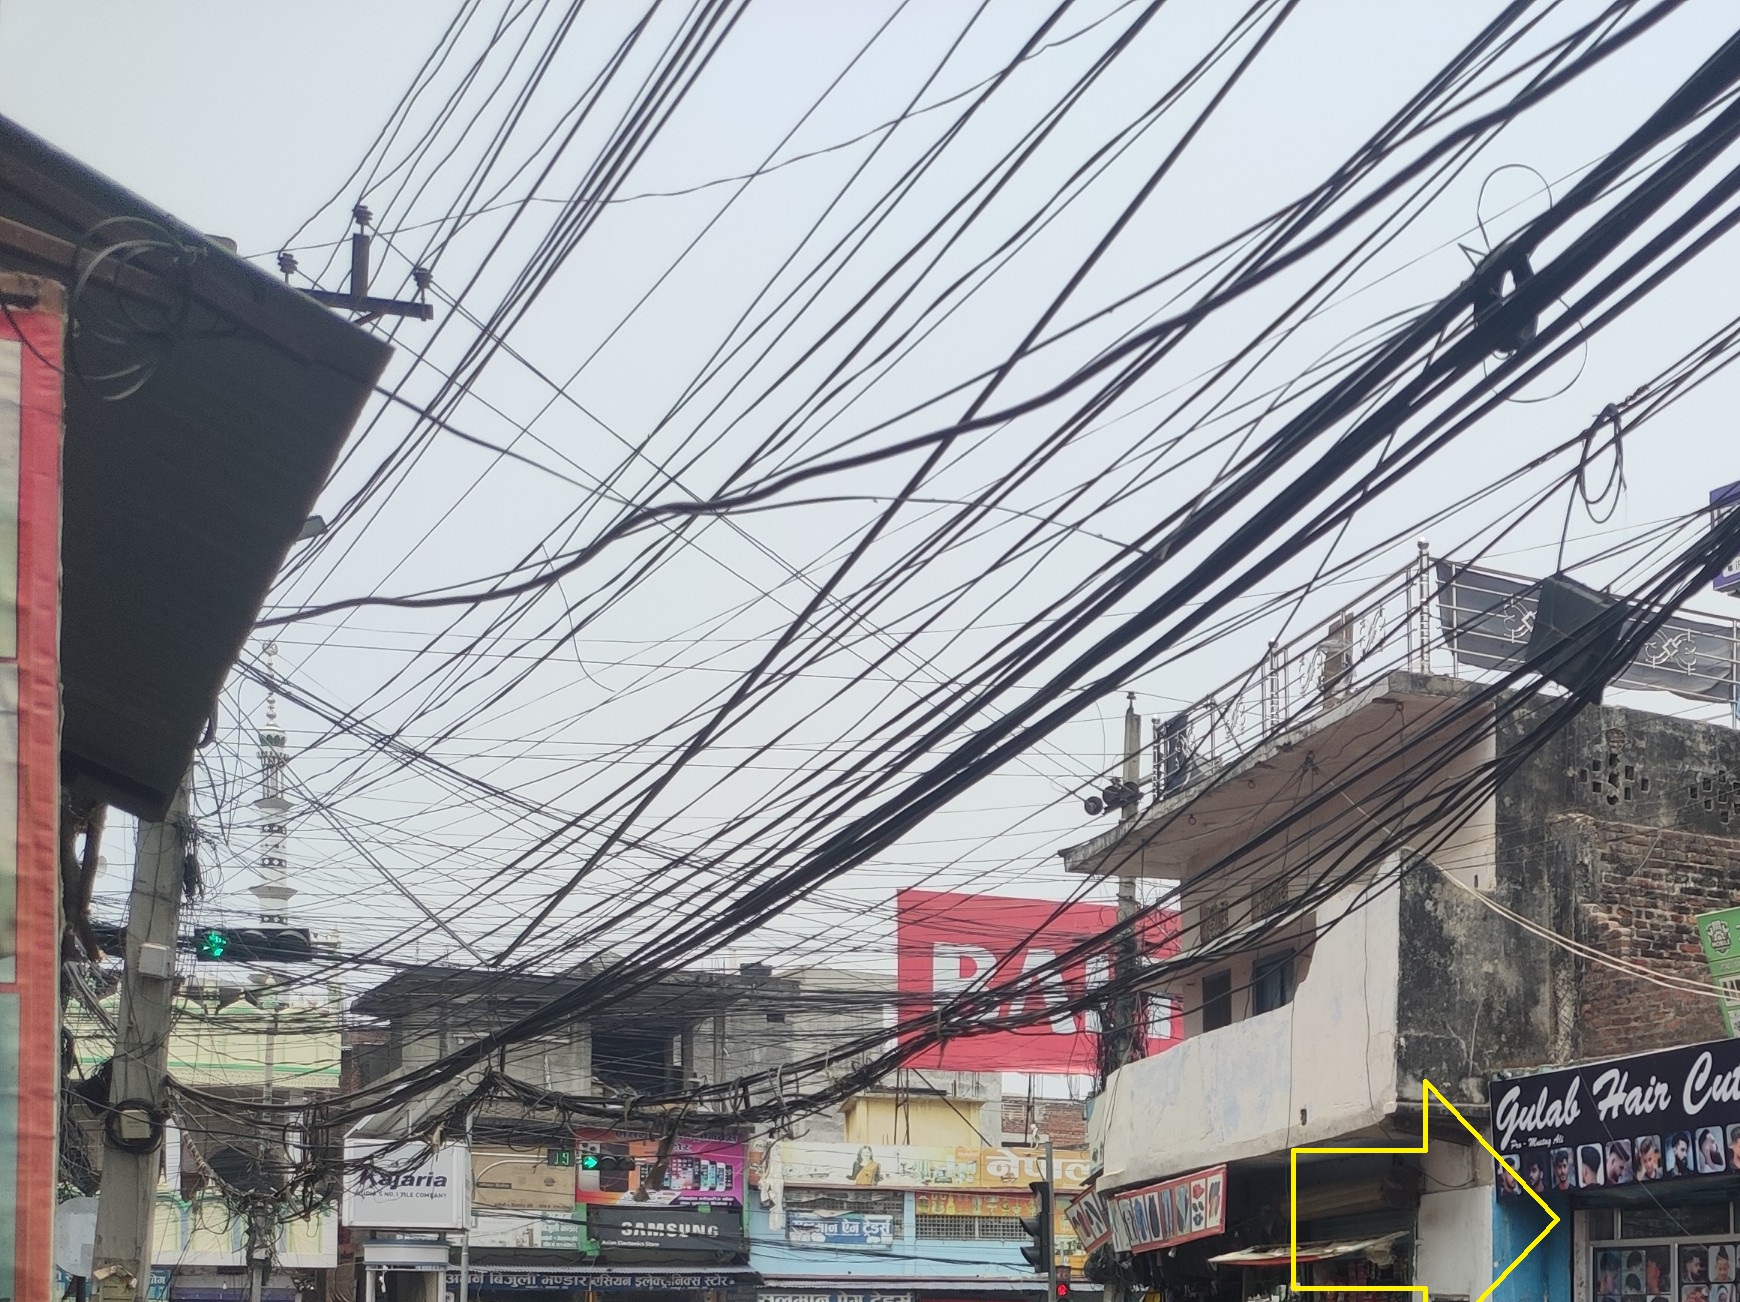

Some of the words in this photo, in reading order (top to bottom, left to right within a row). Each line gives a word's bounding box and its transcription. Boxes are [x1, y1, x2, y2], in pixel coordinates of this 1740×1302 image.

[1496, 1075, 1580, 1150] Gulab
[1592, 1067, 1671, 1121] Hair
[621, 1221, 720, 1239] SAMSUNG
